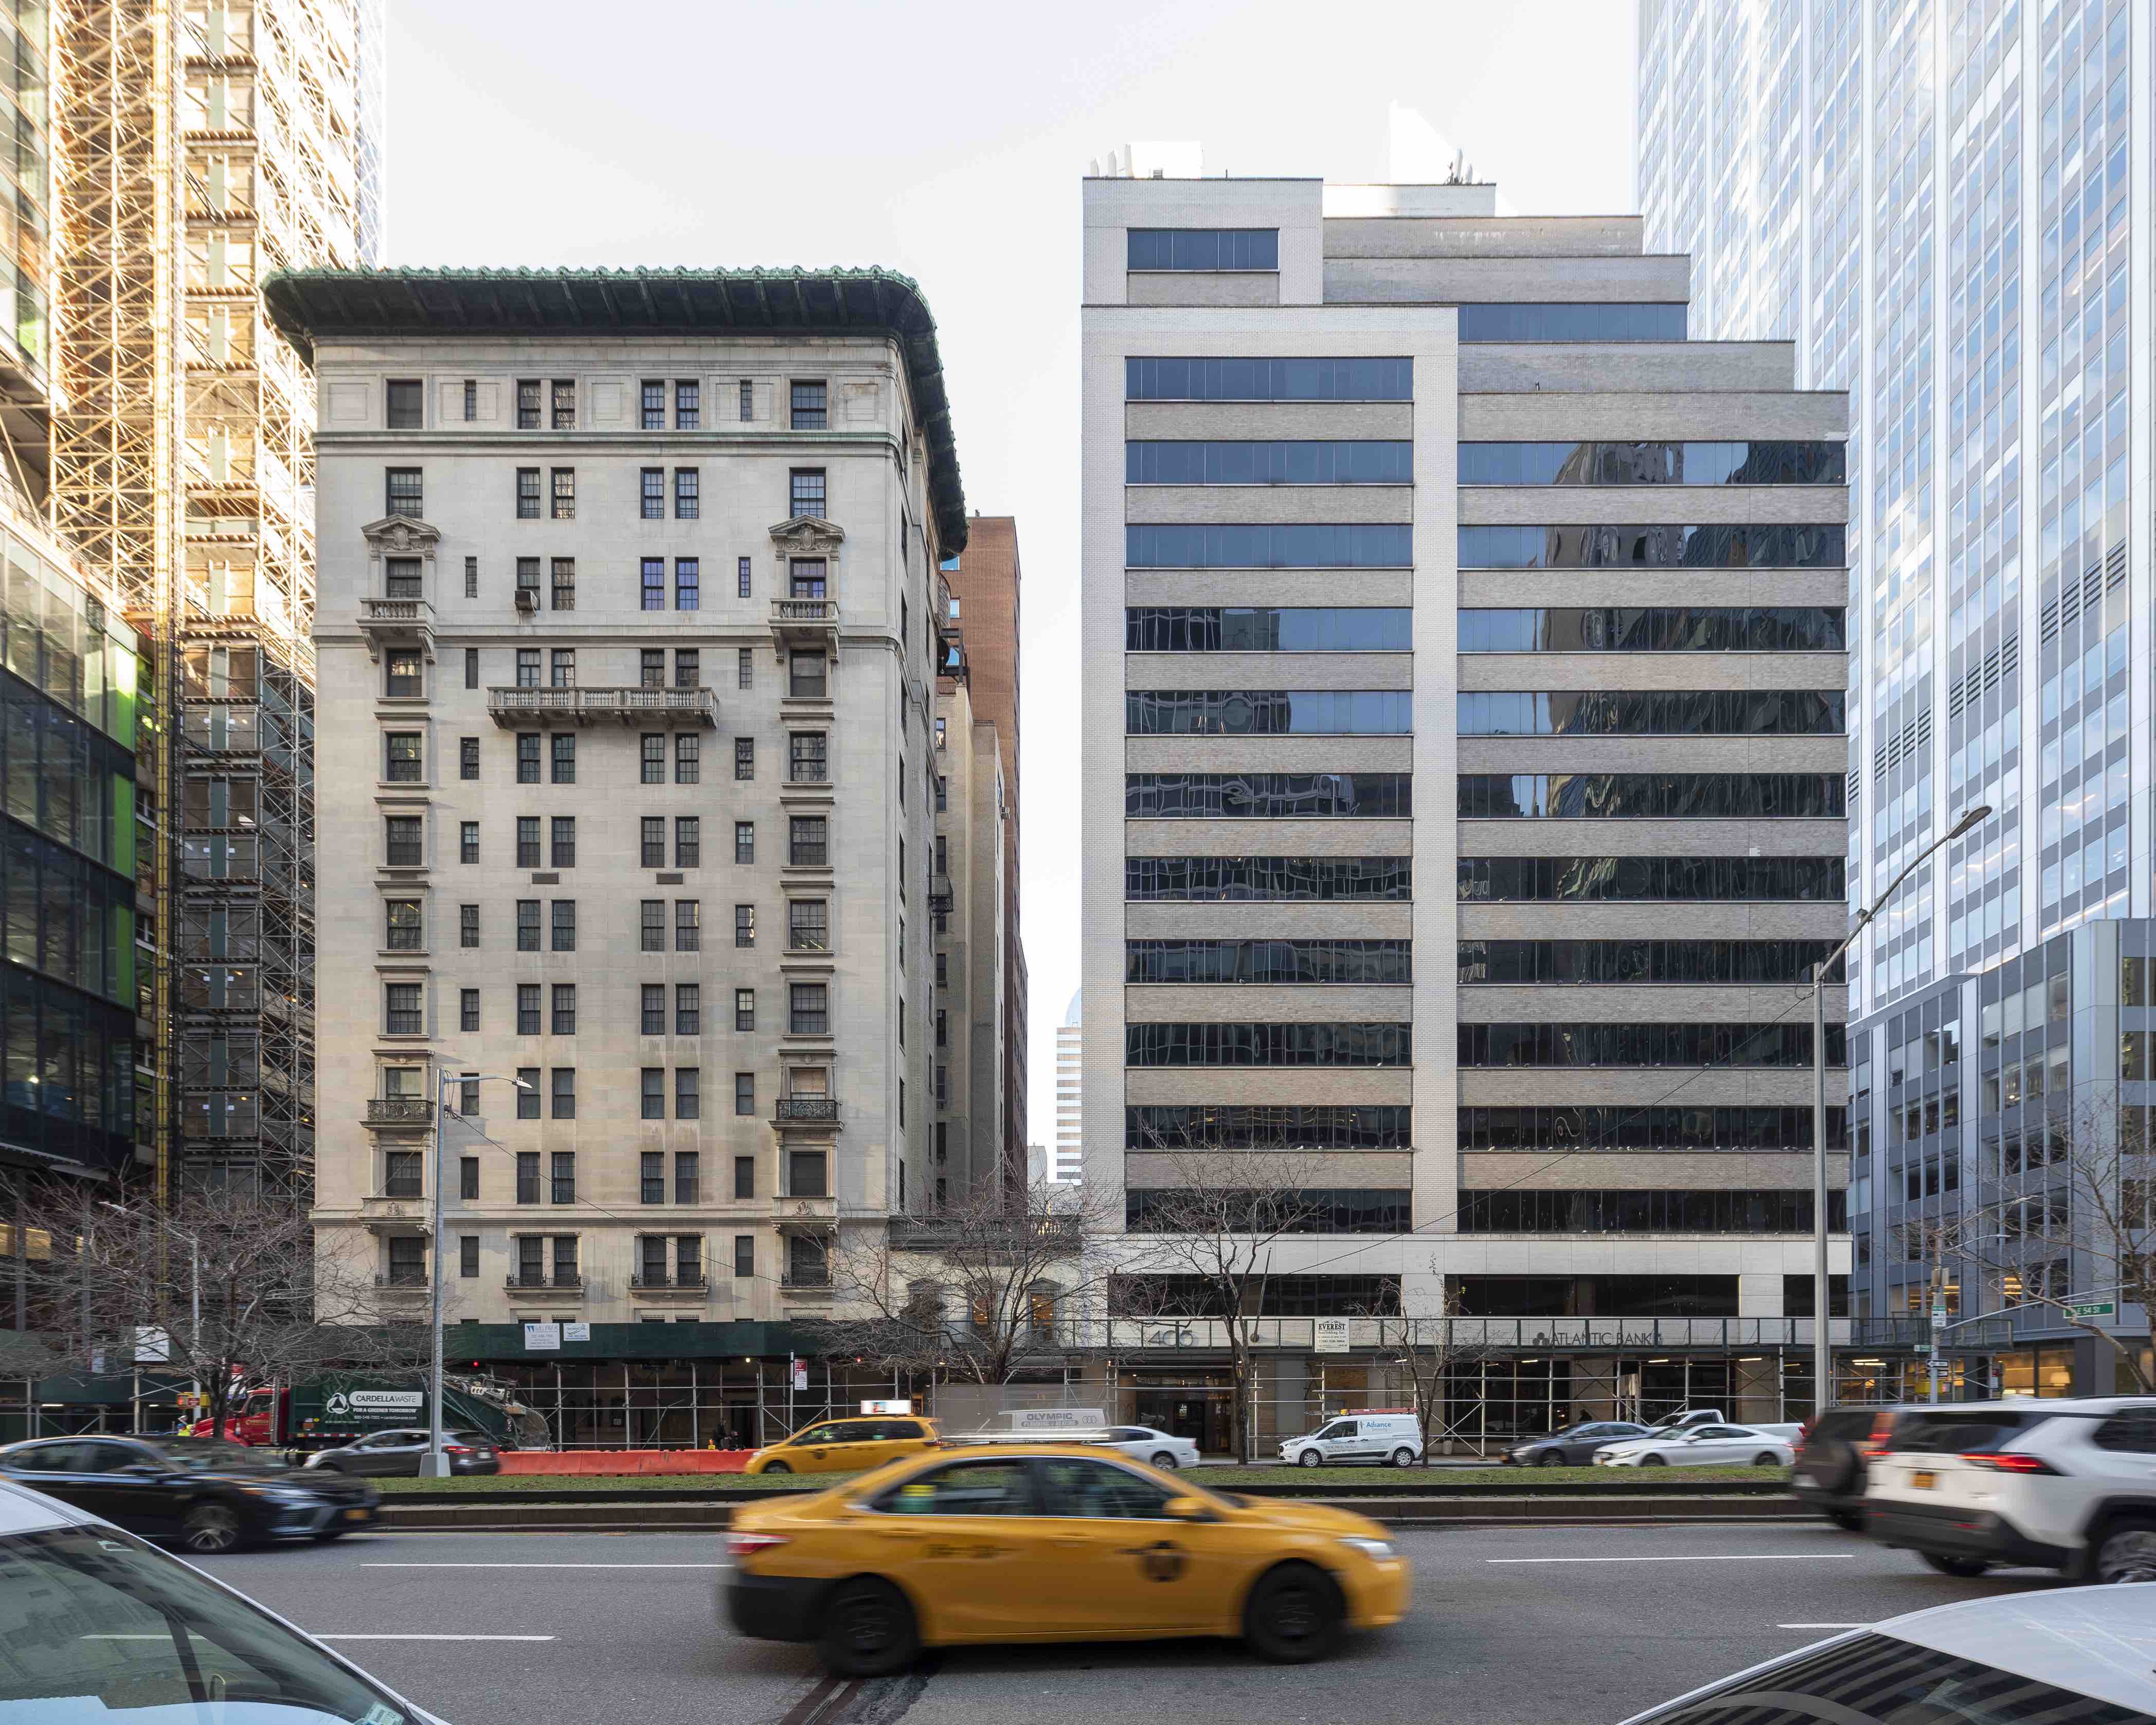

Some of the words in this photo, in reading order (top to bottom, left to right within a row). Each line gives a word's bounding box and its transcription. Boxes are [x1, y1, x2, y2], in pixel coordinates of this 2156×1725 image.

[1147, 1330, 1194, 1346] 405
[1550, 1333, 1612, 1345] ATLANTIC
[1616, 1333, 1652, 1345] BANK
[1027, 1412, 1073, 1421] OLYMPIC
